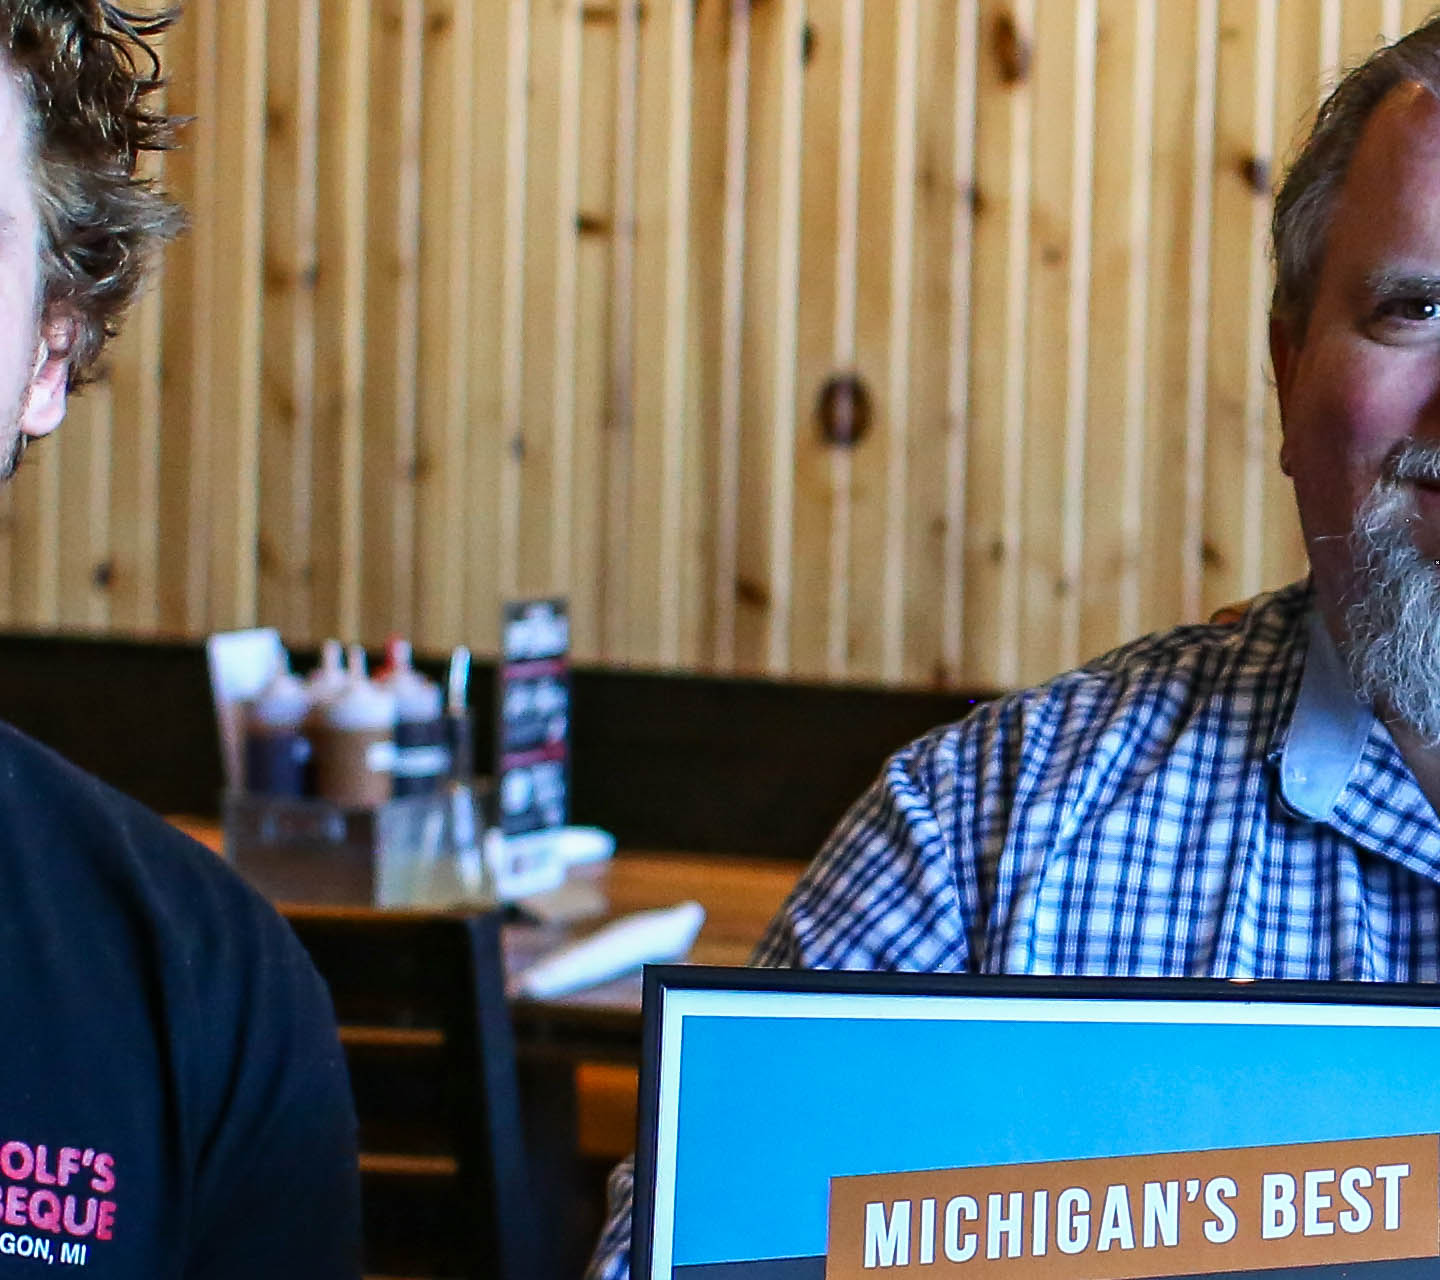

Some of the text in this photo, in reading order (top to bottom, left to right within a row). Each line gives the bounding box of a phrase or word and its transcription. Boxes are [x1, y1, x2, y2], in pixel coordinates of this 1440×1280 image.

[863, 1164, 1410, 1268] MICHIGAN'S BEST
[60, 1242, 87, 1266] MI
